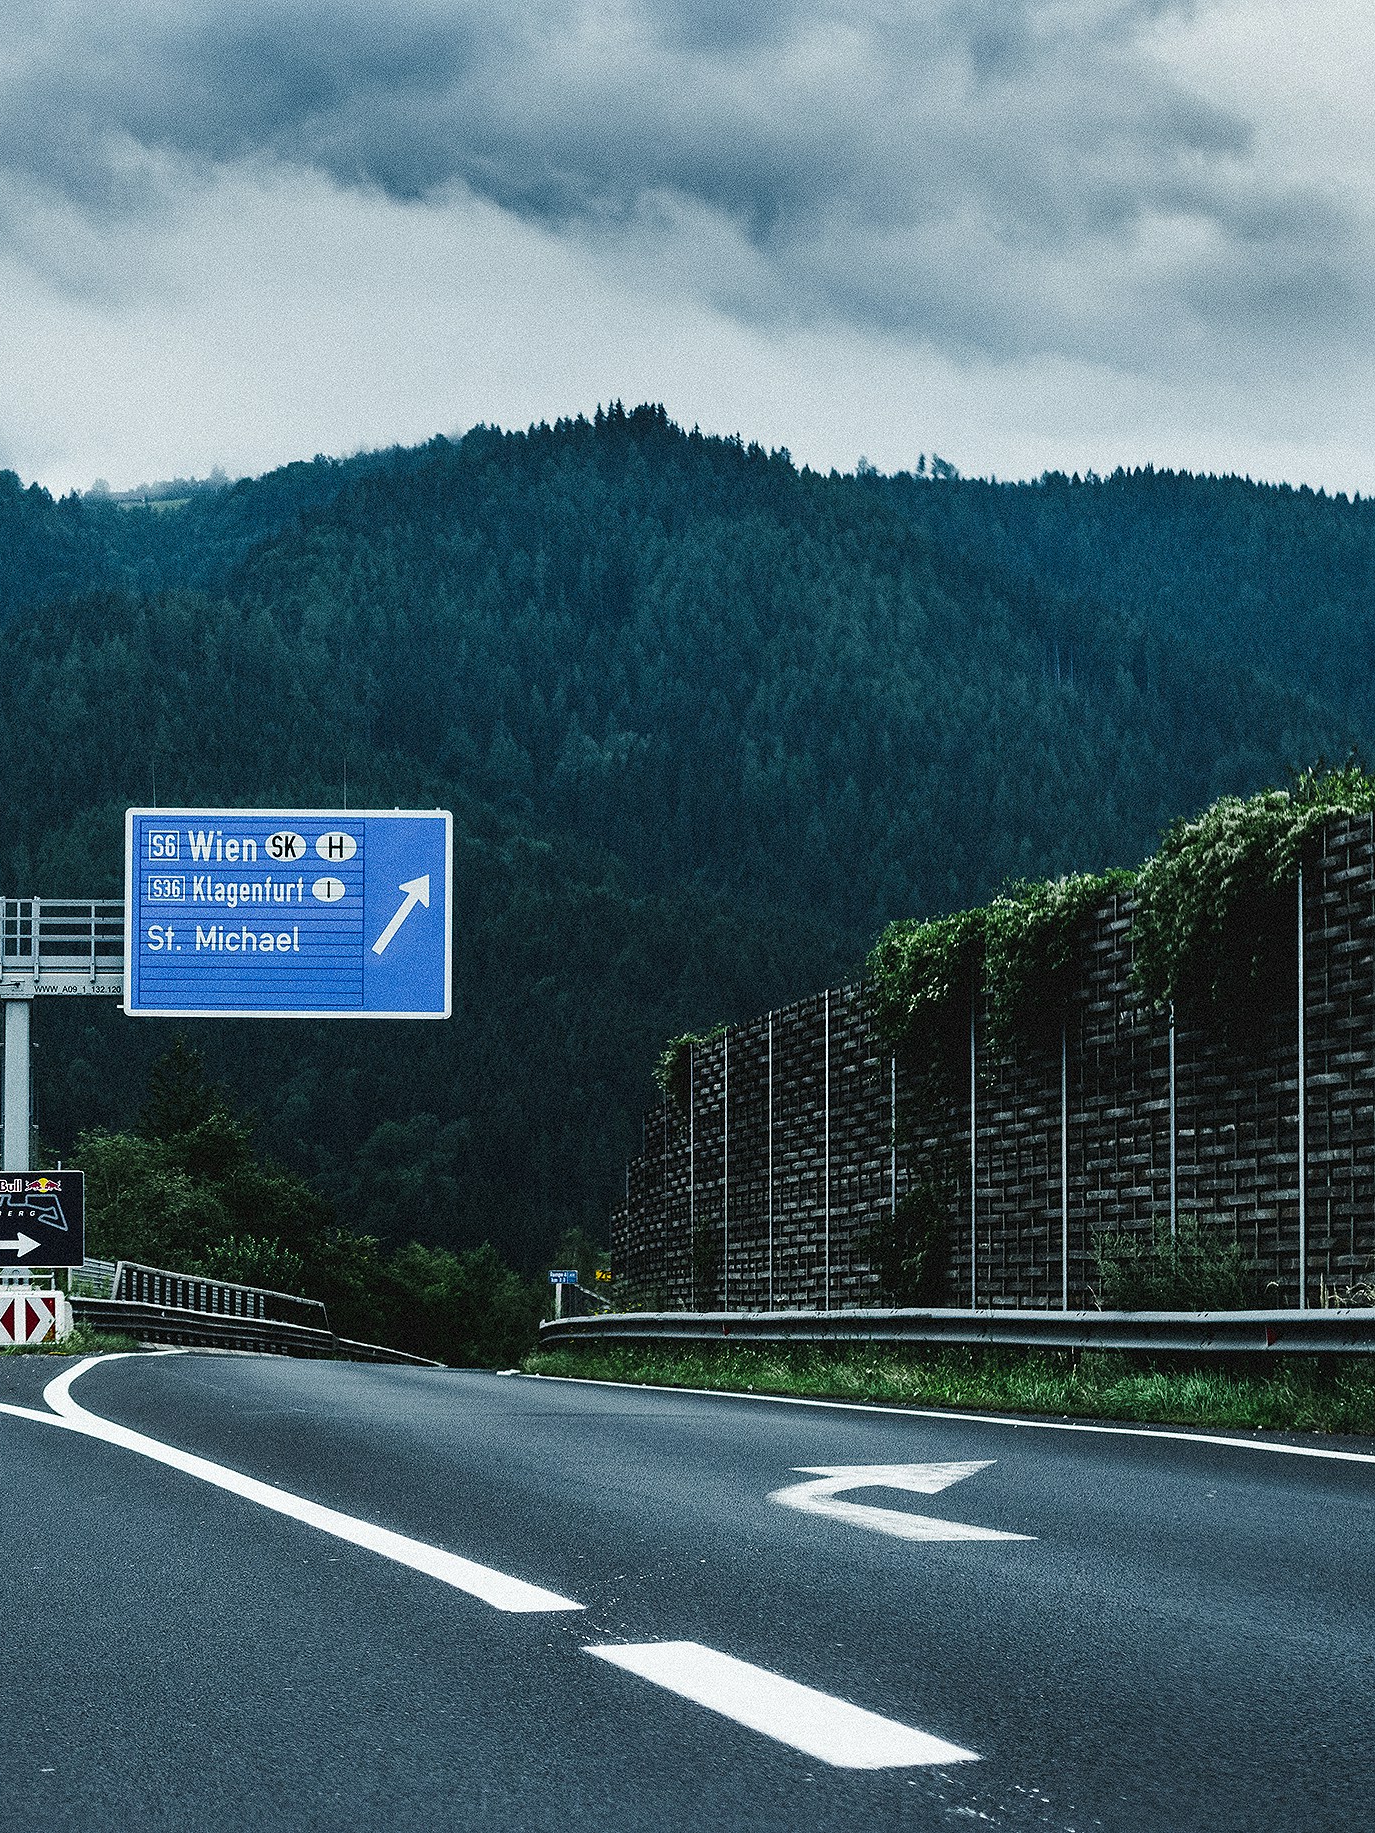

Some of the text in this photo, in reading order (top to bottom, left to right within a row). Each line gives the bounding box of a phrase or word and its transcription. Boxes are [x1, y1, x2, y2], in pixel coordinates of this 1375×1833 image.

[152, 830, 258, 862] S6 Wien
[271, 835, 297, 858] SK
[328, 837, 344, 859] H
[153, 875, 304, 908] S36 Klagenfurt
[147, 925, 300, 952] St. Michael
[0, 1179, 23, 1193] Bull
